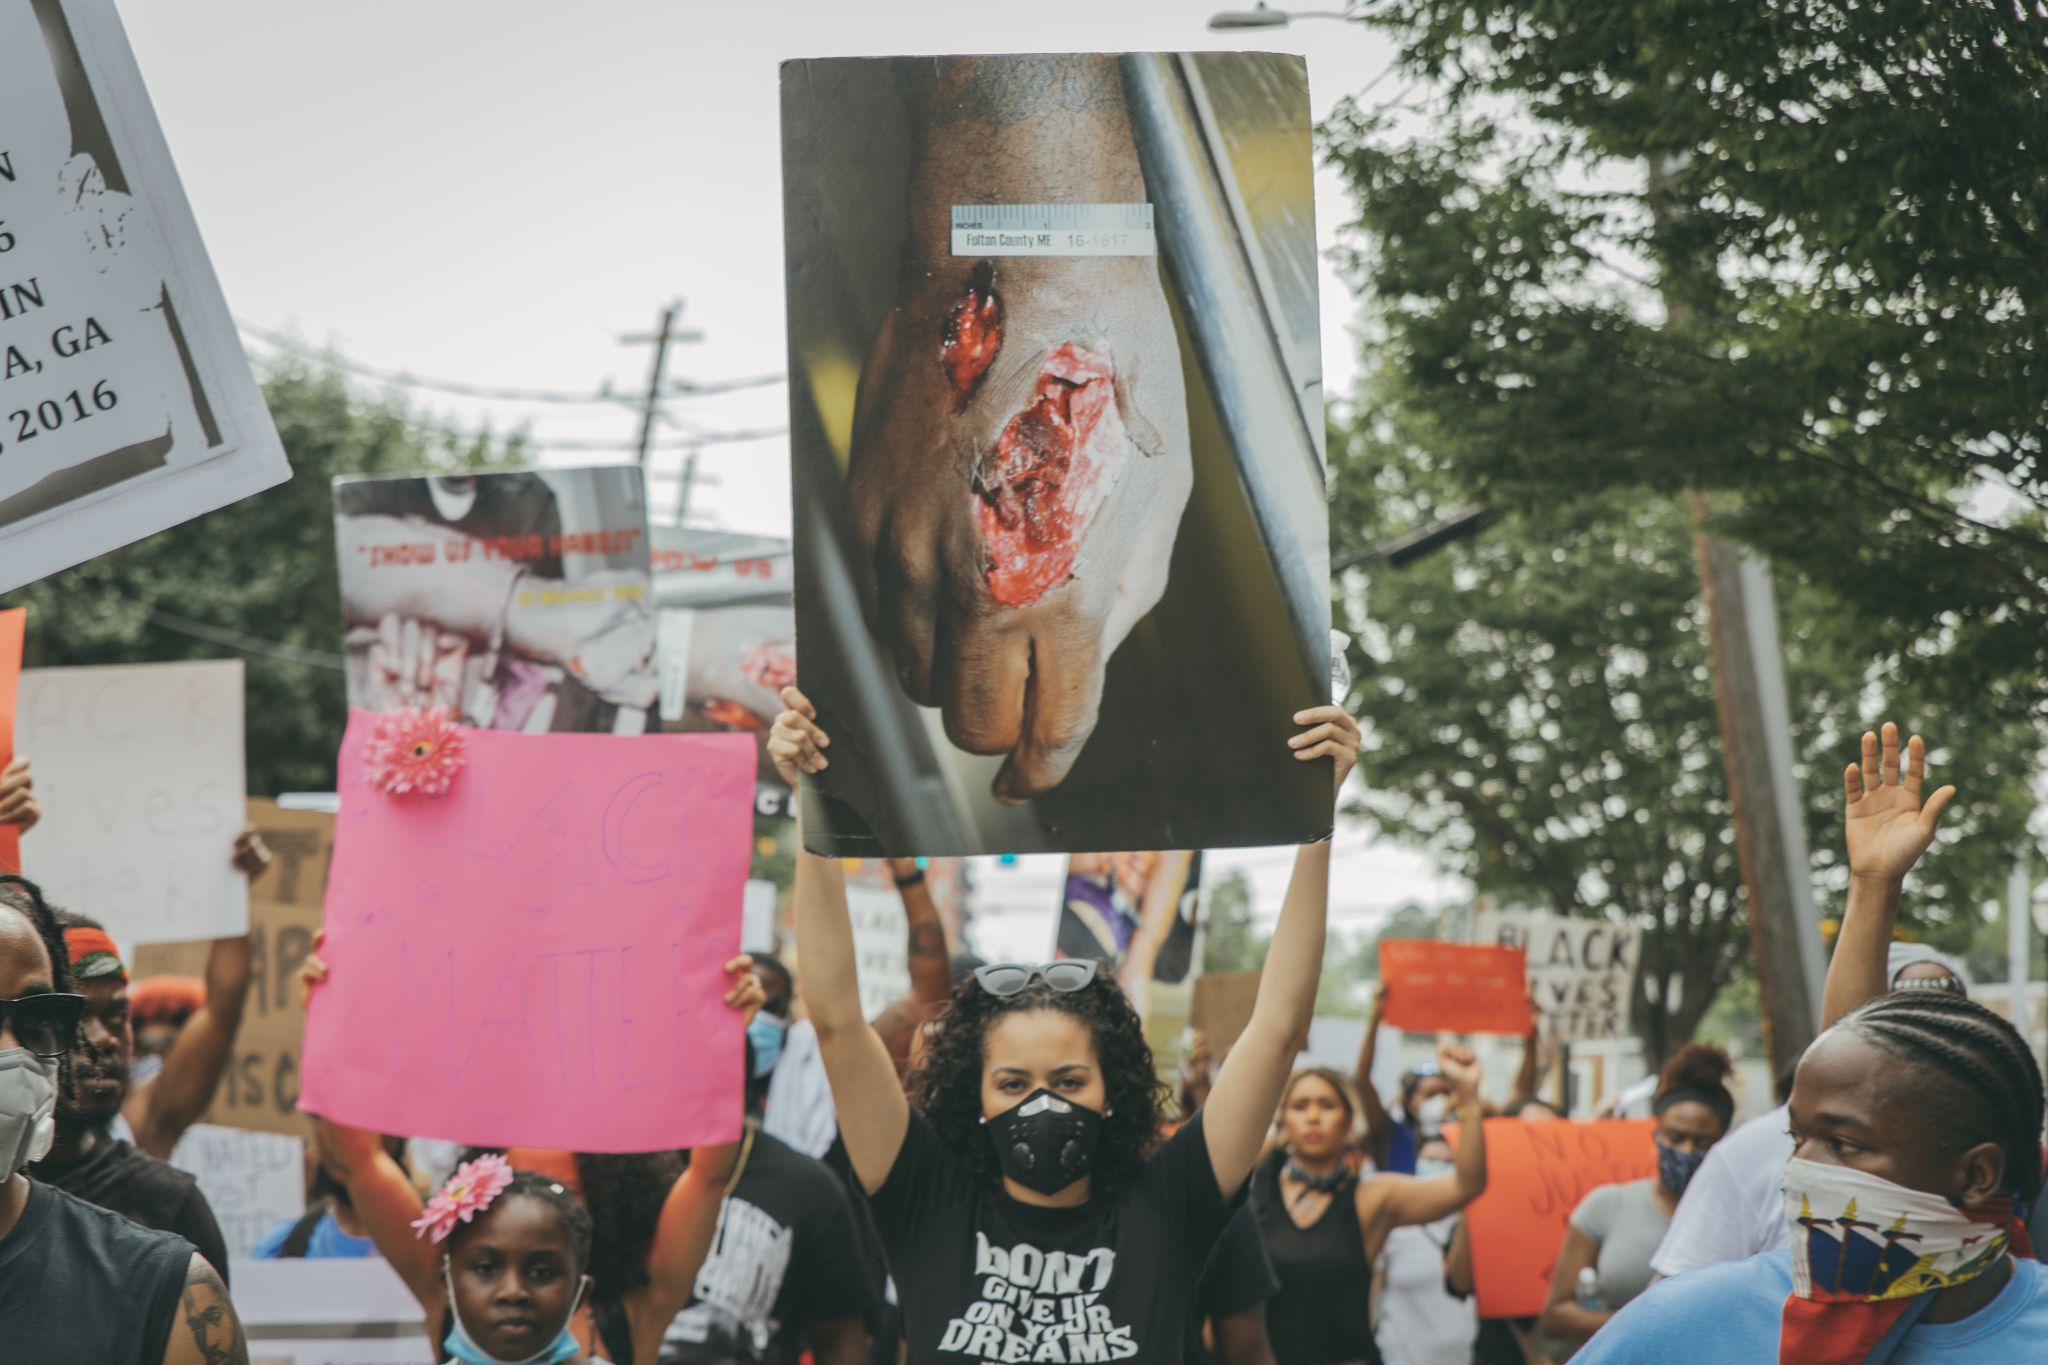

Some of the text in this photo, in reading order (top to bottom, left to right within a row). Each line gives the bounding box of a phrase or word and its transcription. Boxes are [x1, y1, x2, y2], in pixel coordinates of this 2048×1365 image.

[966, 233, 996, 247] Fulton
[1000, 233, 1033, 248] County
[1037, 234, 1051, 247] ME
[51, 316, 113, 359] GA
[9, 379, 118, 443] 2016
[1525, 1126, 1610, 1163] NO
[964, 1301, 1016, 1332] ON
[982, 1276, 1056, 1324] GIVE
[937, 1318, 1139, 1363] DREAMS
